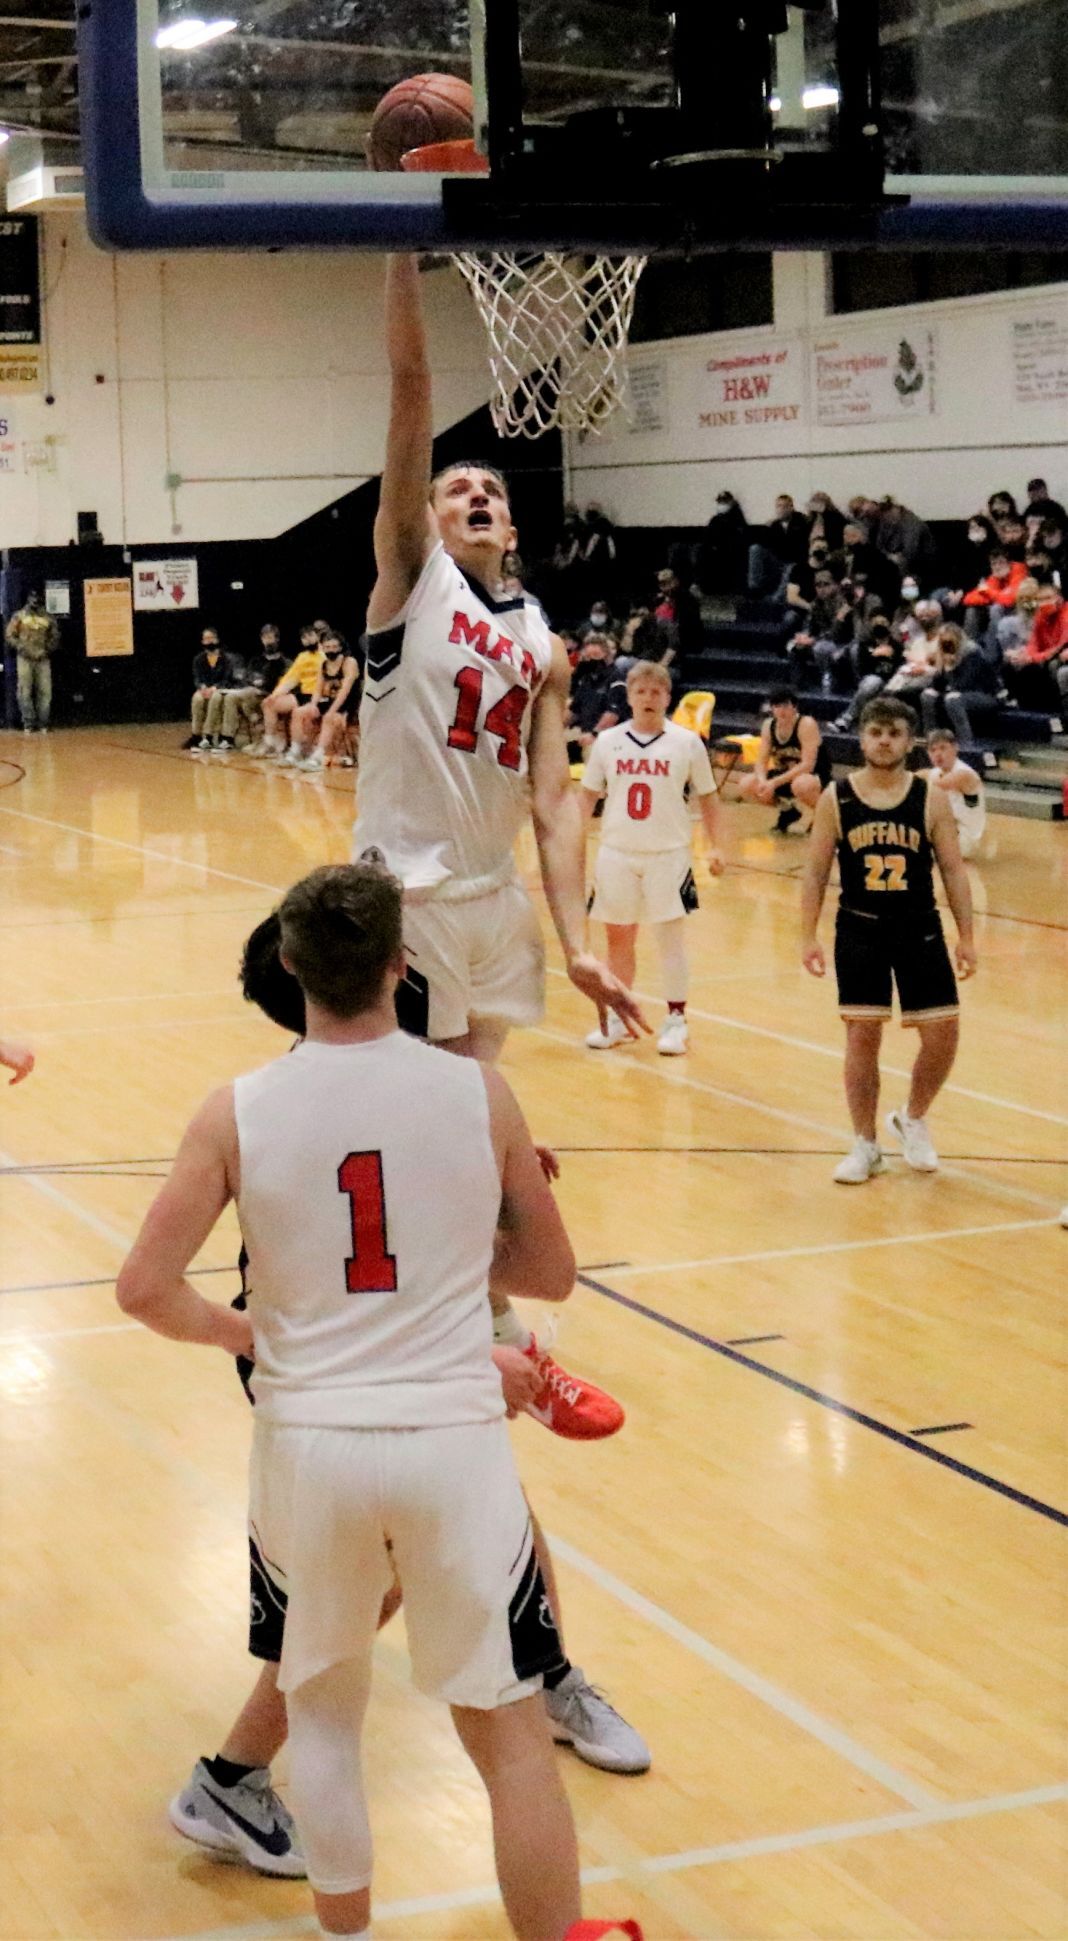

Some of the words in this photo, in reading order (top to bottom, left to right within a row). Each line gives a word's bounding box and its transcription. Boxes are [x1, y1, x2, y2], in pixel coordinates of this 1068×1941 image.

[707, 354, 770, 372] Compliments
[776, 350, 788, 364] of
[723, 374, 772, 402] H&W
[699, 410, 737, 428] MINE
[745, 404, 801, 424] SUPPLY
[447, 665, 529, 771] 14
[616, 759, 670, 776] MAN
[627, 782, 652, 821] 0
[847, 821, 920, 853] BUFFALO
[864, 854, 908, 891] 22
[337, 1149, 397, 1294] 1
